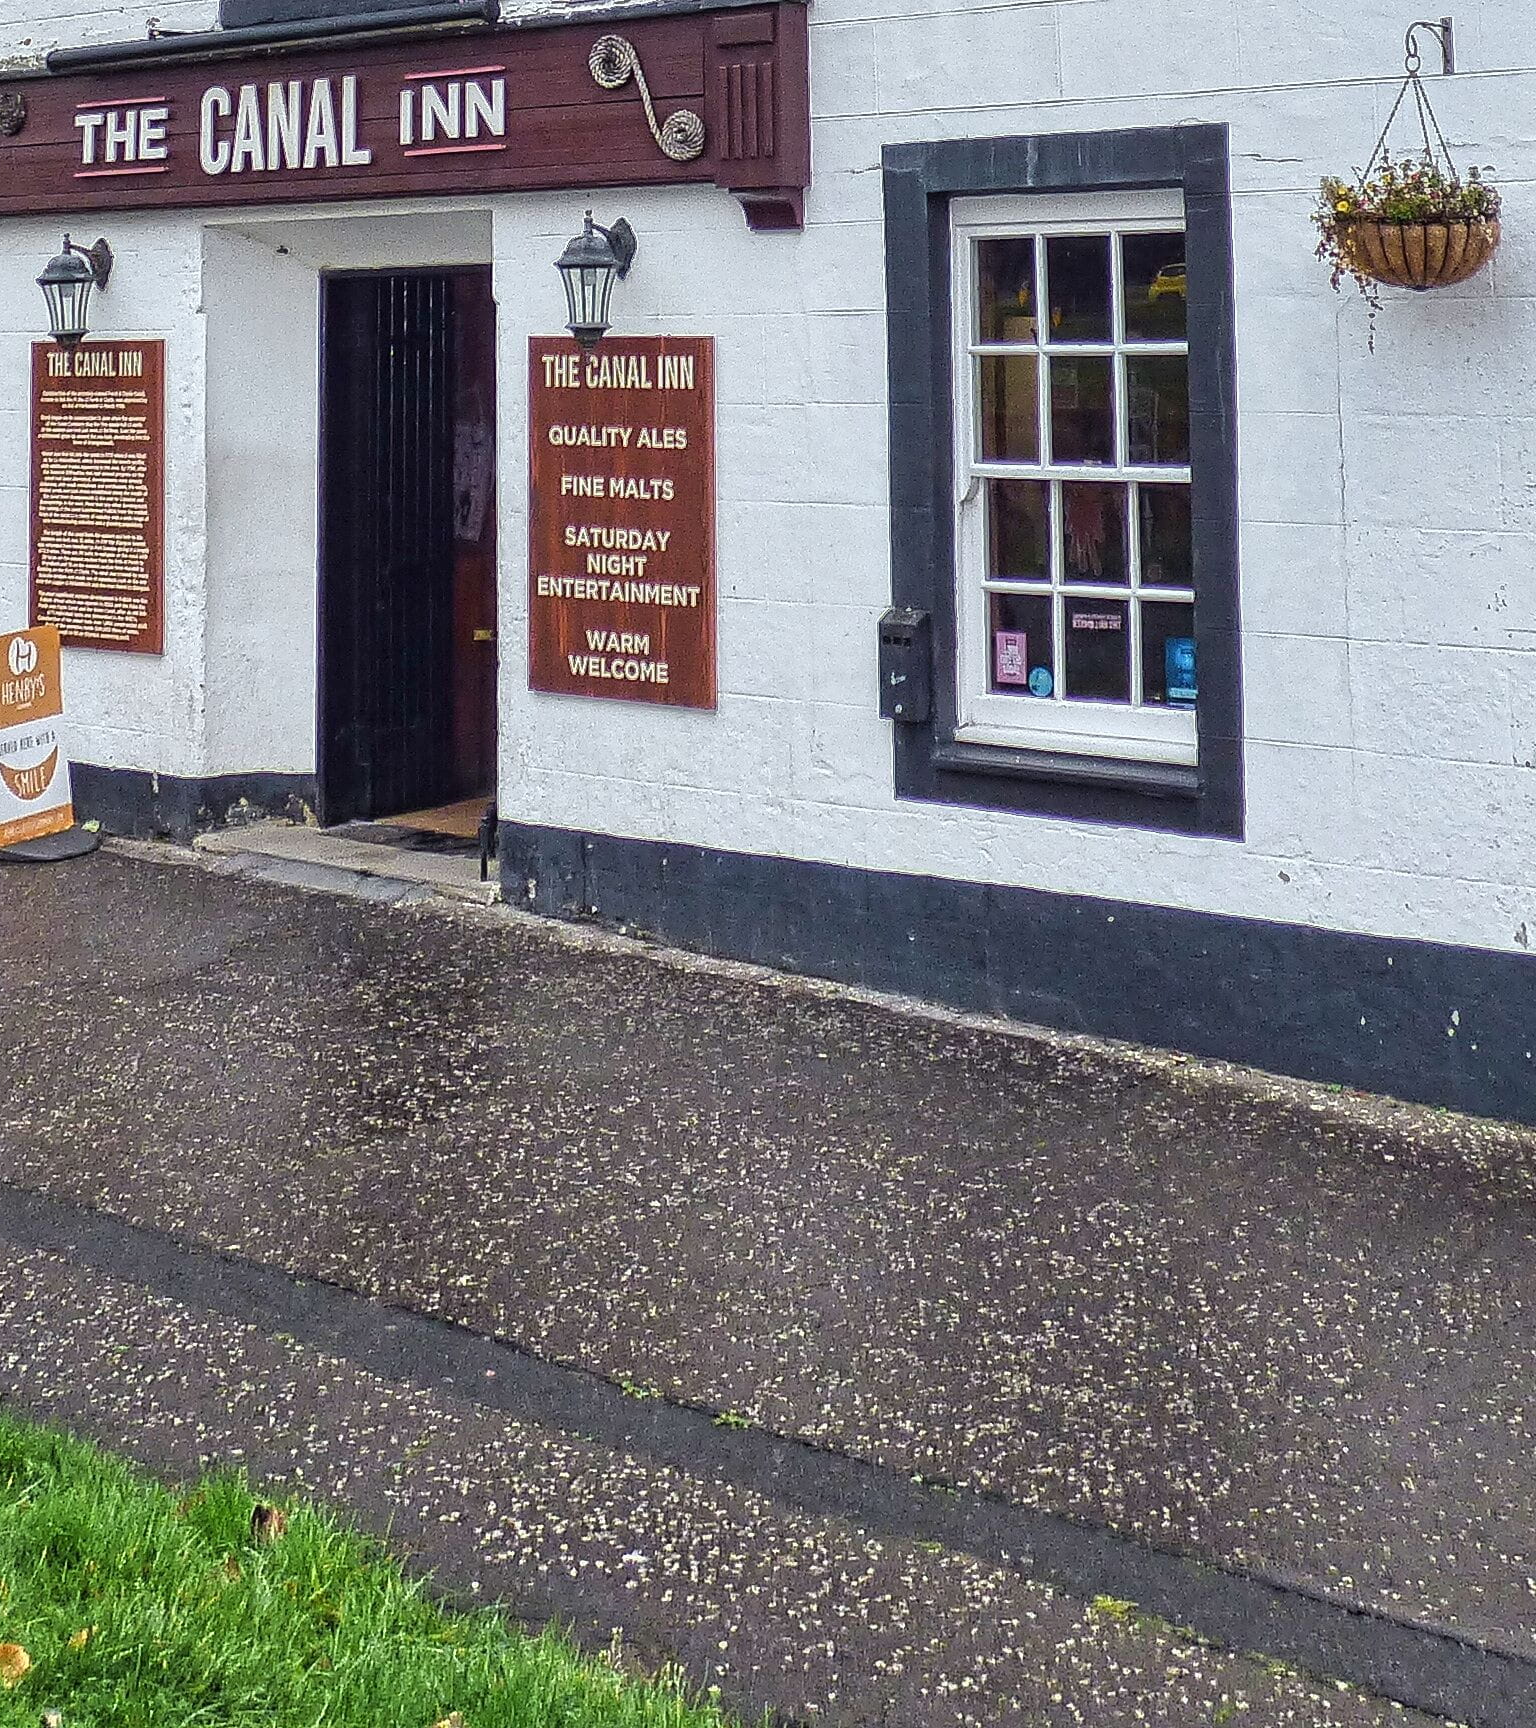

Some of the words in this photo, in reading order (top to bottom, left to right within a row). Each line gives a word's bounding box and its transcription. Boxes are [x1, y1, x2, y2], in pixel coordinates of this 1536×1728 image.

[74, 108, 169, 165] THE
[199, 75, 372, 176] CANAL
[398, 78, 506, 146] INN
[47, 351, 71, 377] THE
[74, 351, 116, 377] CANAL
[118, 351, 143, 377] INN
[542, 354, 580, 389] THE
[585, 355, 652, 390] CANAL
[657, 355, 694, 390] INN
[548, 425, 633, 448] QUALITY
[637, 427, 687, 449] ALES
[561, 476, 605, 498] FINE
[609, 478, 675, 500] MALTS
[564, 526, 670, 552] SATURDAY
[587, 554, 647, 576] NIGHT
[537, 576, 700, 607] ENTERTAINMENT
[586, 631, 650, 655] WARM
[568, 655, 669, 683] WELCOME
[1, 673, 45, 705] HENRY'S
[14, 766, 47, 796] SMILE
